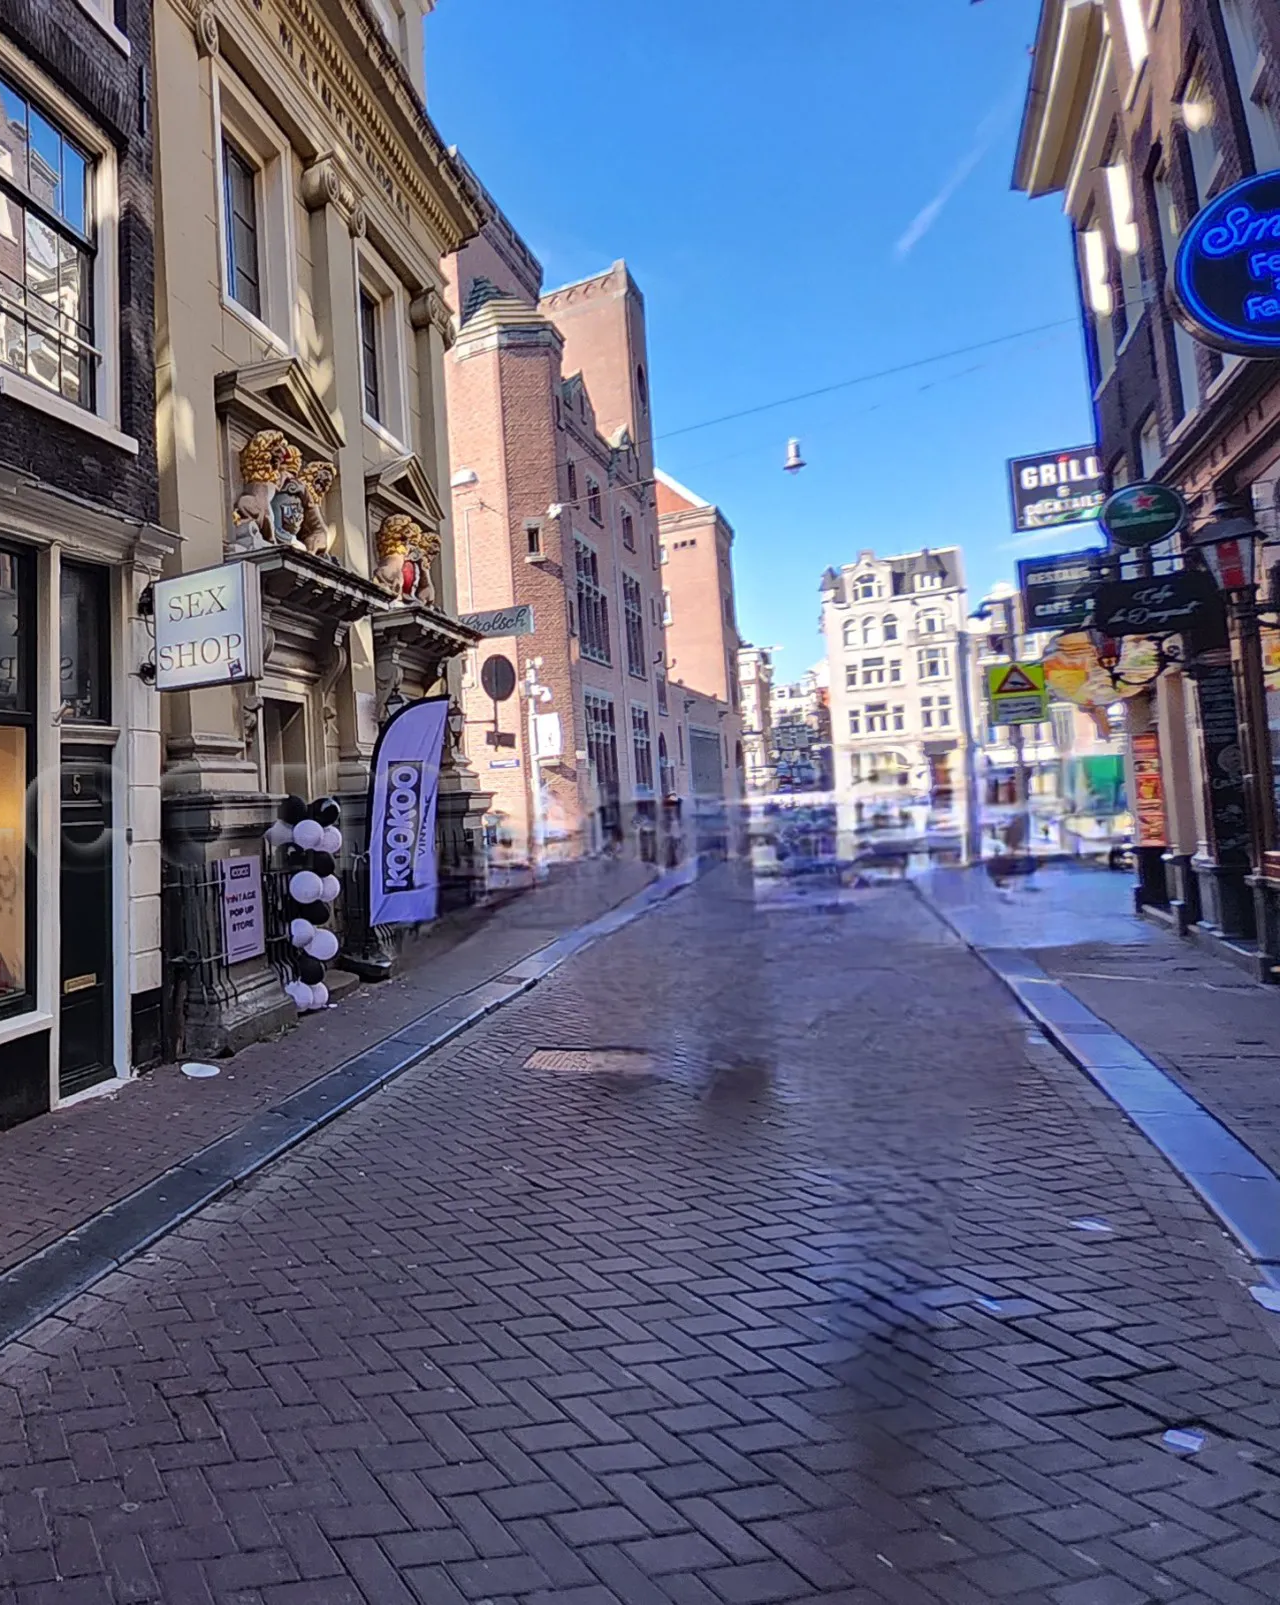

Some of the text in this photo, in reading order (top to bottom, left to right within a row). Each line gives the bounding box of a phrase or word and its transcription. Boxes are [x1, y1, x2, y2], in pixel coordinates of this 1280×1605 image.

[1021, 453, 1104, 490] GRILL
[168, 585, 227, 623] SEX
[159, 633, 242, 672] SHOP
[73, 774, 81, 795] 5
[385, 765, 418, 887] KOOKOO
